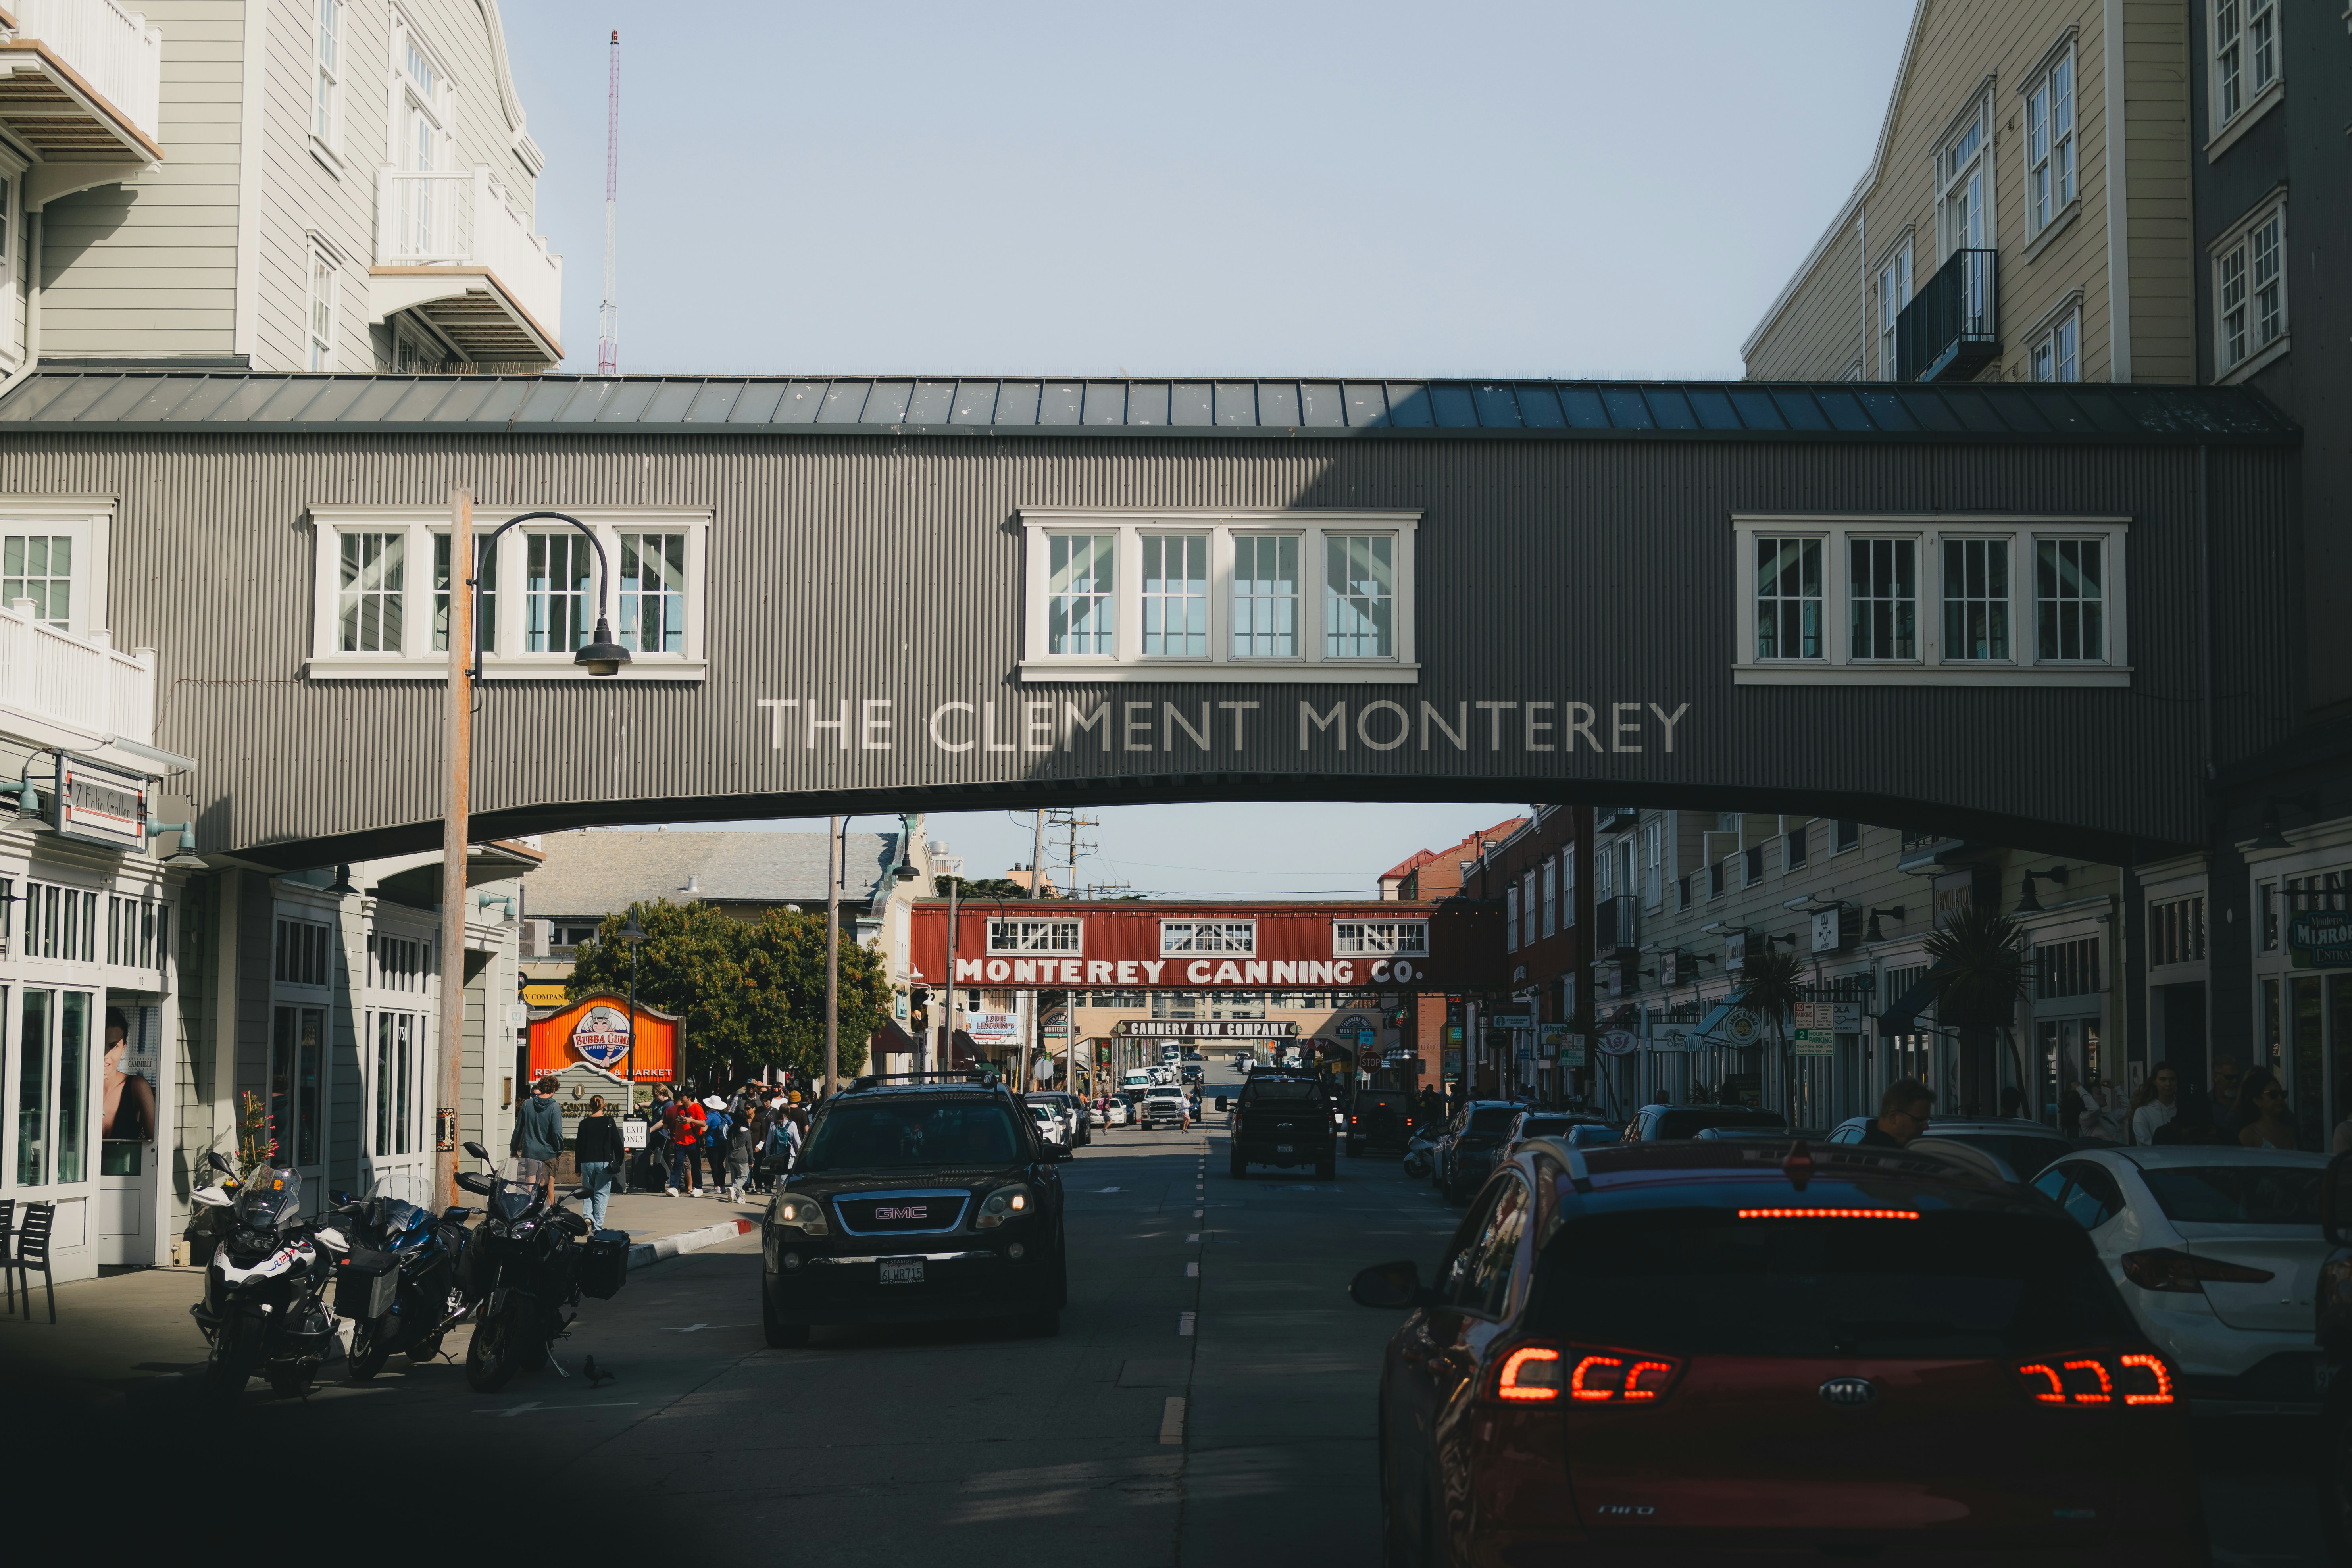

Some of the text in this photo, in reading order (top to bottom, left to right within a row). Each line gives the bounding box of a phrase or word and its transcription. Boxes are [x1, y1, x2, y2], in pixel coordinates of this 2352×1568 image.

[757, 698, 1691, 752] THE CLEMENT MONTEREY
[76, 783, 134, 826] Z Folio Gallery
[1935, 884, 1971, 917] PENDLETON
[1820, 913, 1829, 926] LOLA
[2311, 916, 2344, 928] Monterey
[956, 958, 1423, 984] MONTEREY CANNING CO.
[1048, 1015, 1065, 1025] CANNERY
[1343, 1016, 1369, 1027] CANNERY ROW
[1729, 1012, 1746, 1026] JACK'S
[398, 1026, 407, 1041] 750
[1131, 1022, 1287, 1035] CANNERY ROW COMPANY
[576, 1034, 605, 1045] BUBBA
[1362, 1058, 1380, 1067] STOP
[876, 1206, 927, 1220] GMC
[882, 1267, 922, 1280] 6LWR715
[1829, 1384, 1868, 1401] KIA
